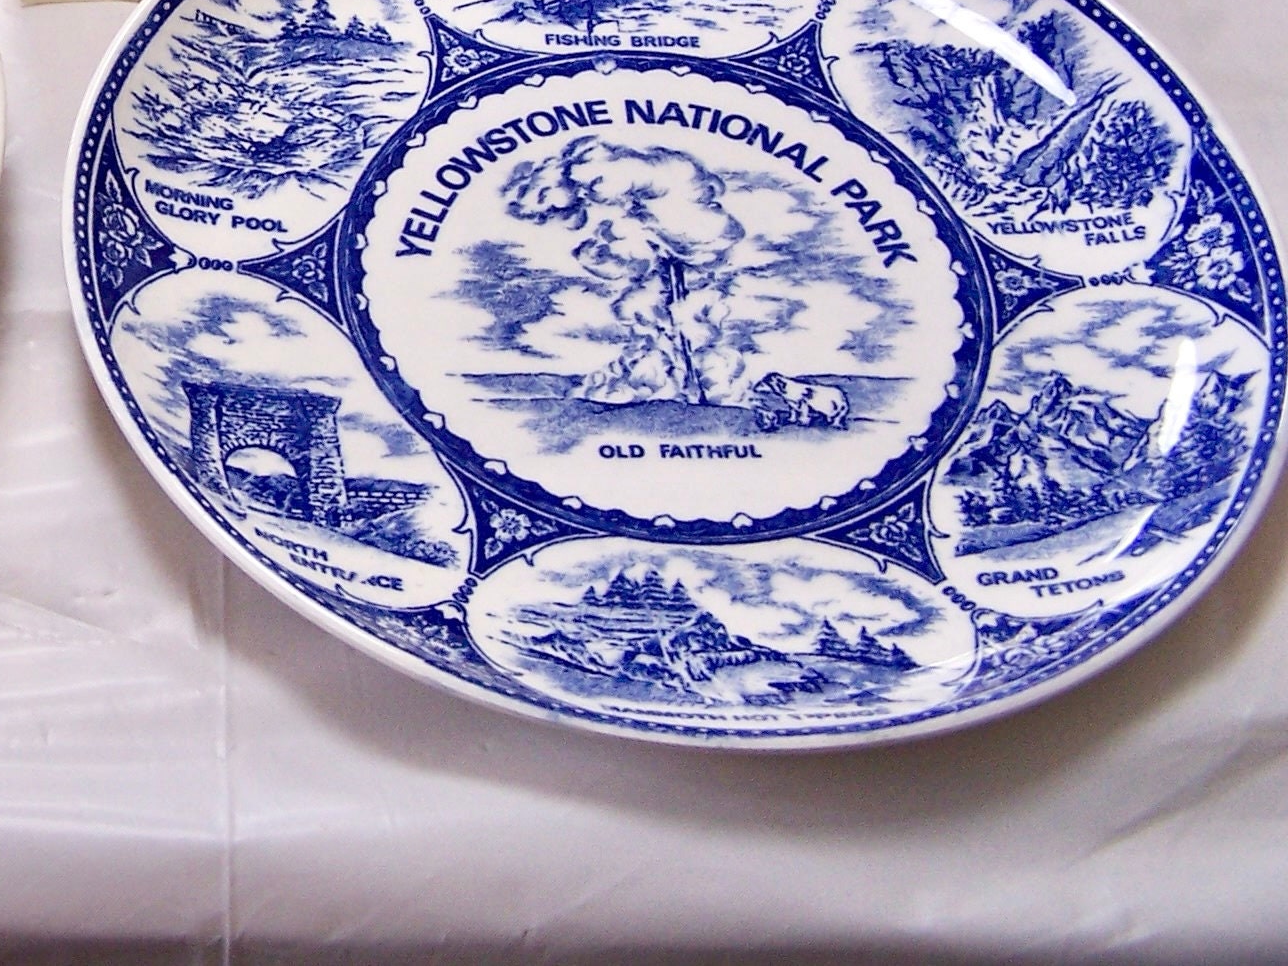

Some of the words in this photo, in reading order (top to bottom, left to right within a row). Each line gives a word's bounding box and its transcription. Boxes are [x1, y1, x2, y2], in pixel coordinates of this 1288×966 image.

[544, 33, 622, 47] FISHING
[629, 35, 702, 48] BRIDGE
[144, 178, 235, 212] MORNING
[394, 98, 614, 260] YELLOWSTONE
[624, 98, 832, 184] NATIONAL
[829, 177, 919, 268] PARK
[154, 200, 221, 226] GLORY
[230, 215, 289, 234] POOL
[1083, 225, 1147, 247] FALLS
[598, 444, 646, 459] OLD
[659, 444, 763, 459] FAITHFUL
[253, 526, 329, 562] NORTH
[976, 566, 1060, 587] GRAND
[1029, 570, 1126, 599] TETONS
